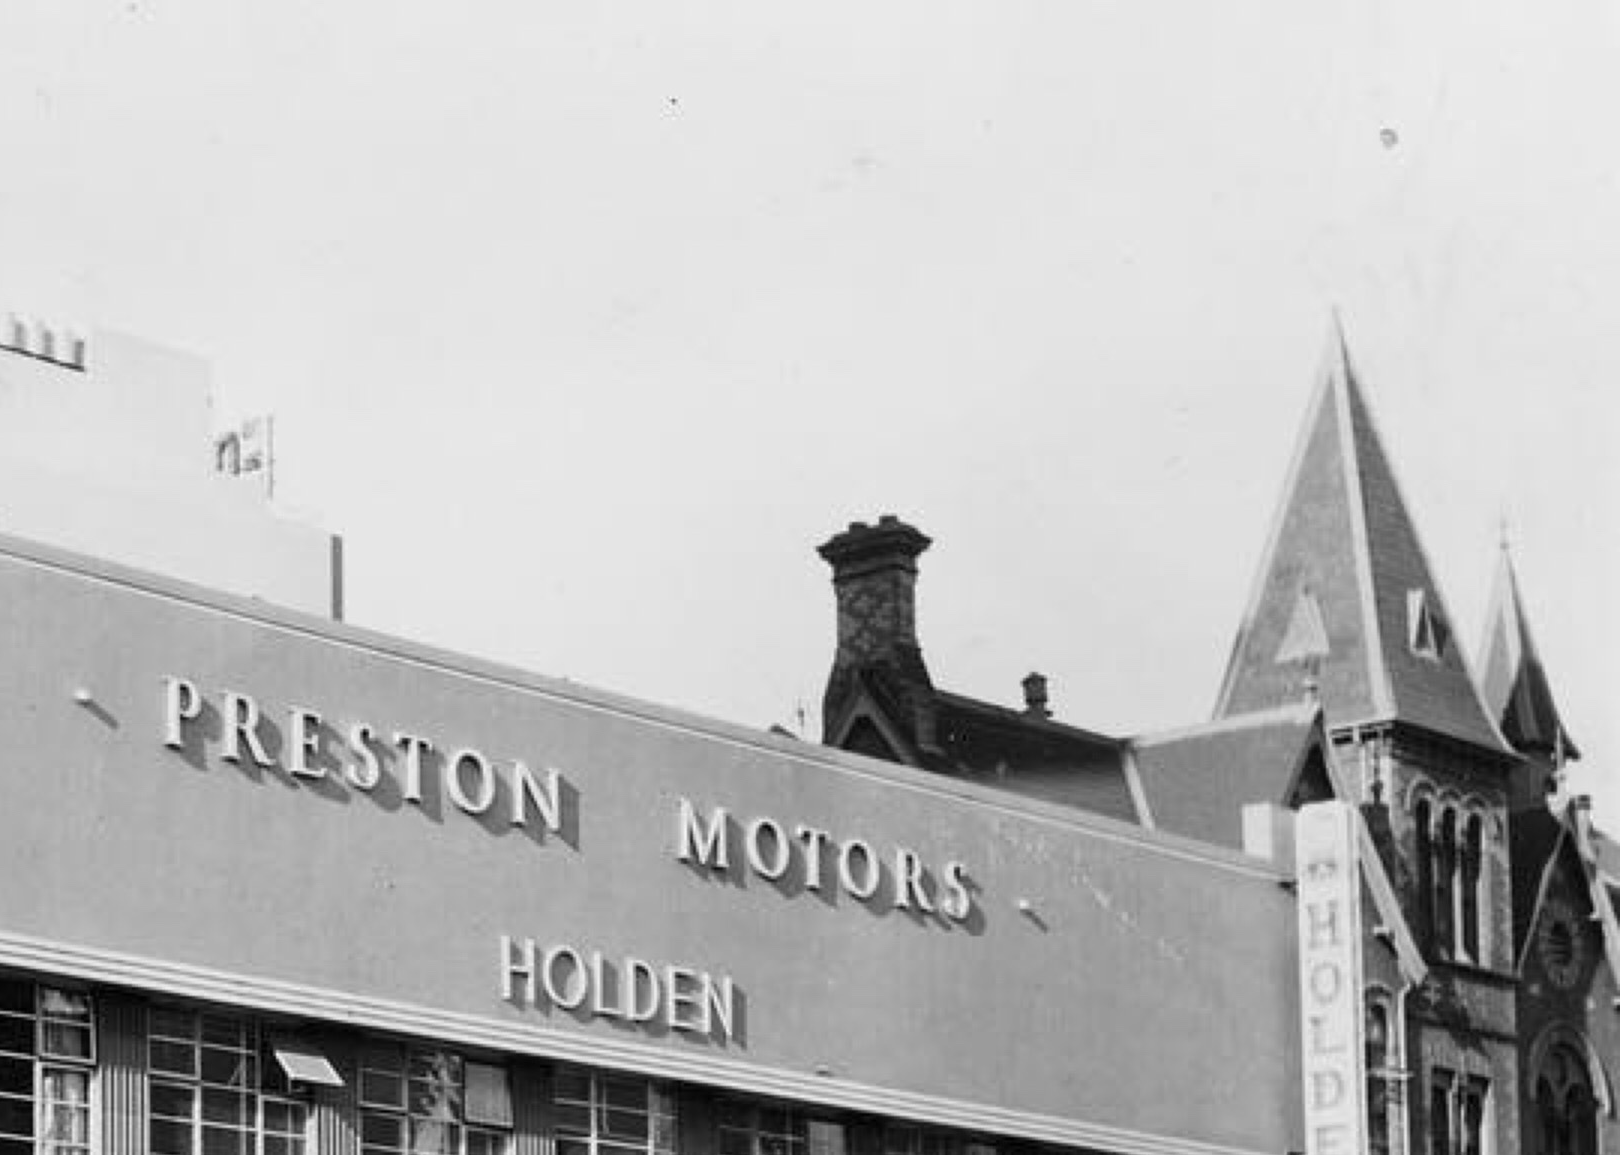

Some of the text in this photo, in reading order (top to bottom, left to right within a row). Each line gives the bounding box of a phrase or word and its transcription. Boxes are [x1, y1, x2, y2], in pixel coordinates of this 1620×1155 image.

[163, 675, 973, 921] PRESTON MOTORS
[498, 934, 738, 1037] HOLDEN
